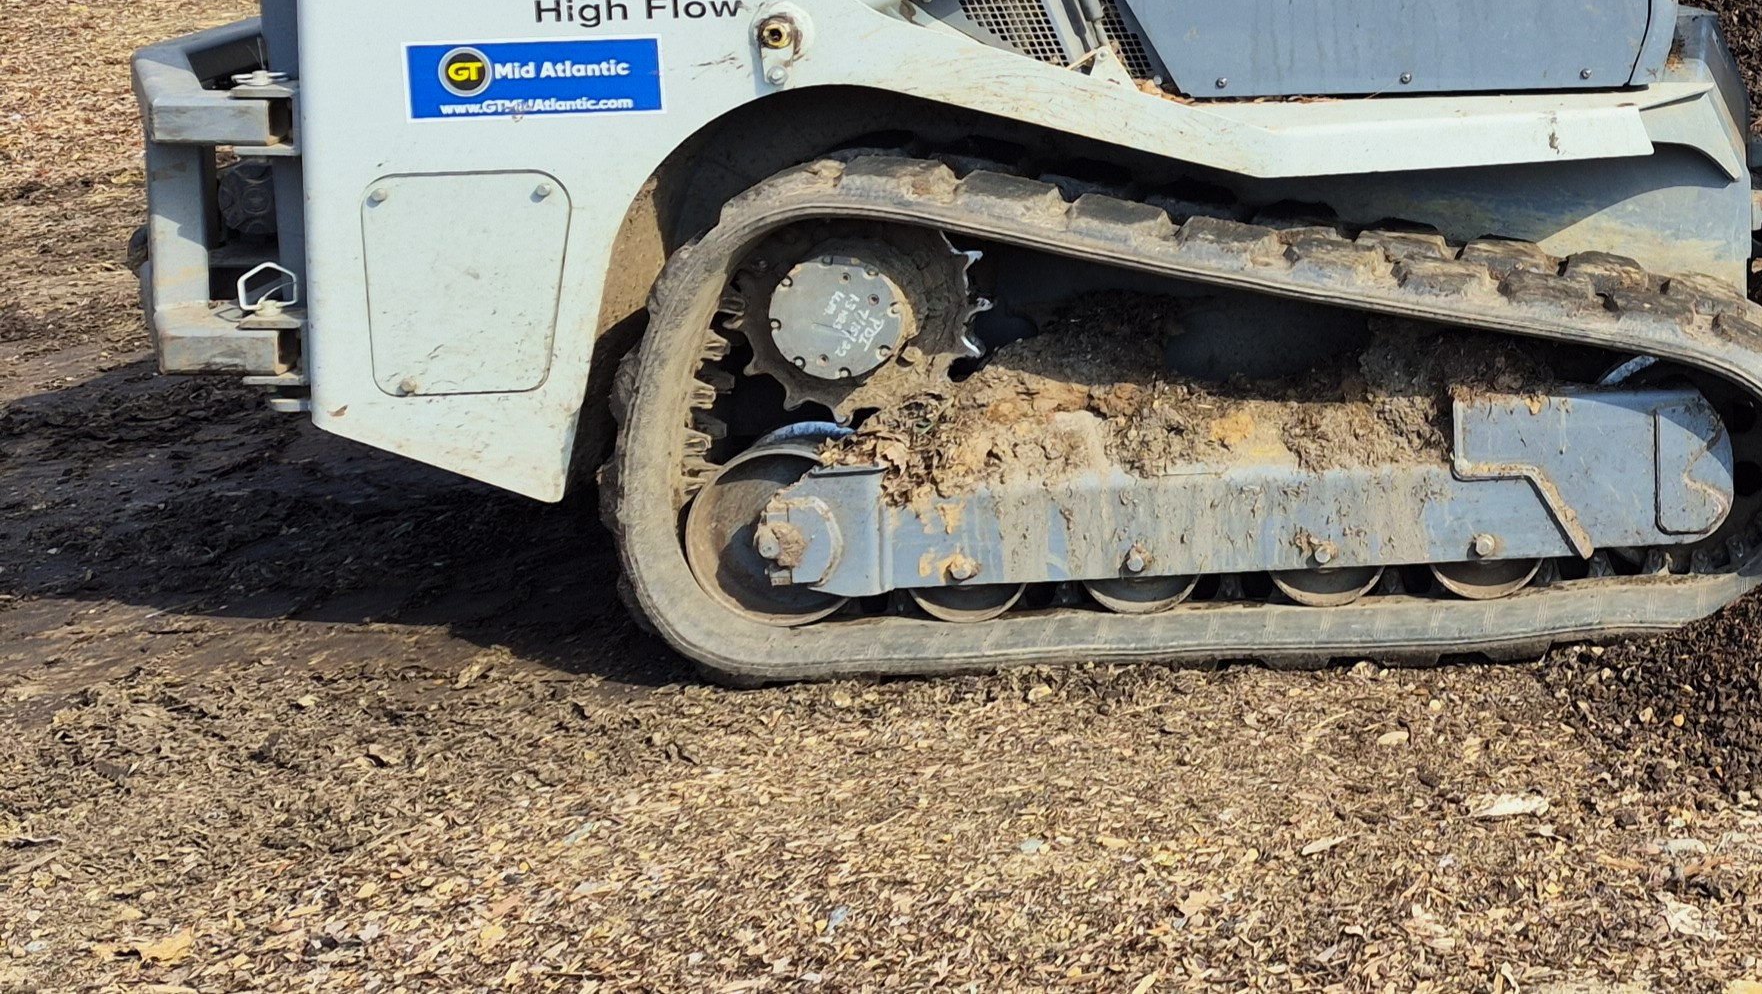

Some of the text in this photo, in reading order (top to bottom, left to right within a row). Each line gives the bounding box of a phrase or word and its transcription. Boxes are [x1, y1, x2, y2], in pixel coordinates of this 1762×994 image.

[447, 59, 632, 82] GT Mid Atlantic
[440, 96, 634, 116] www.GTMidAtlantic.com
